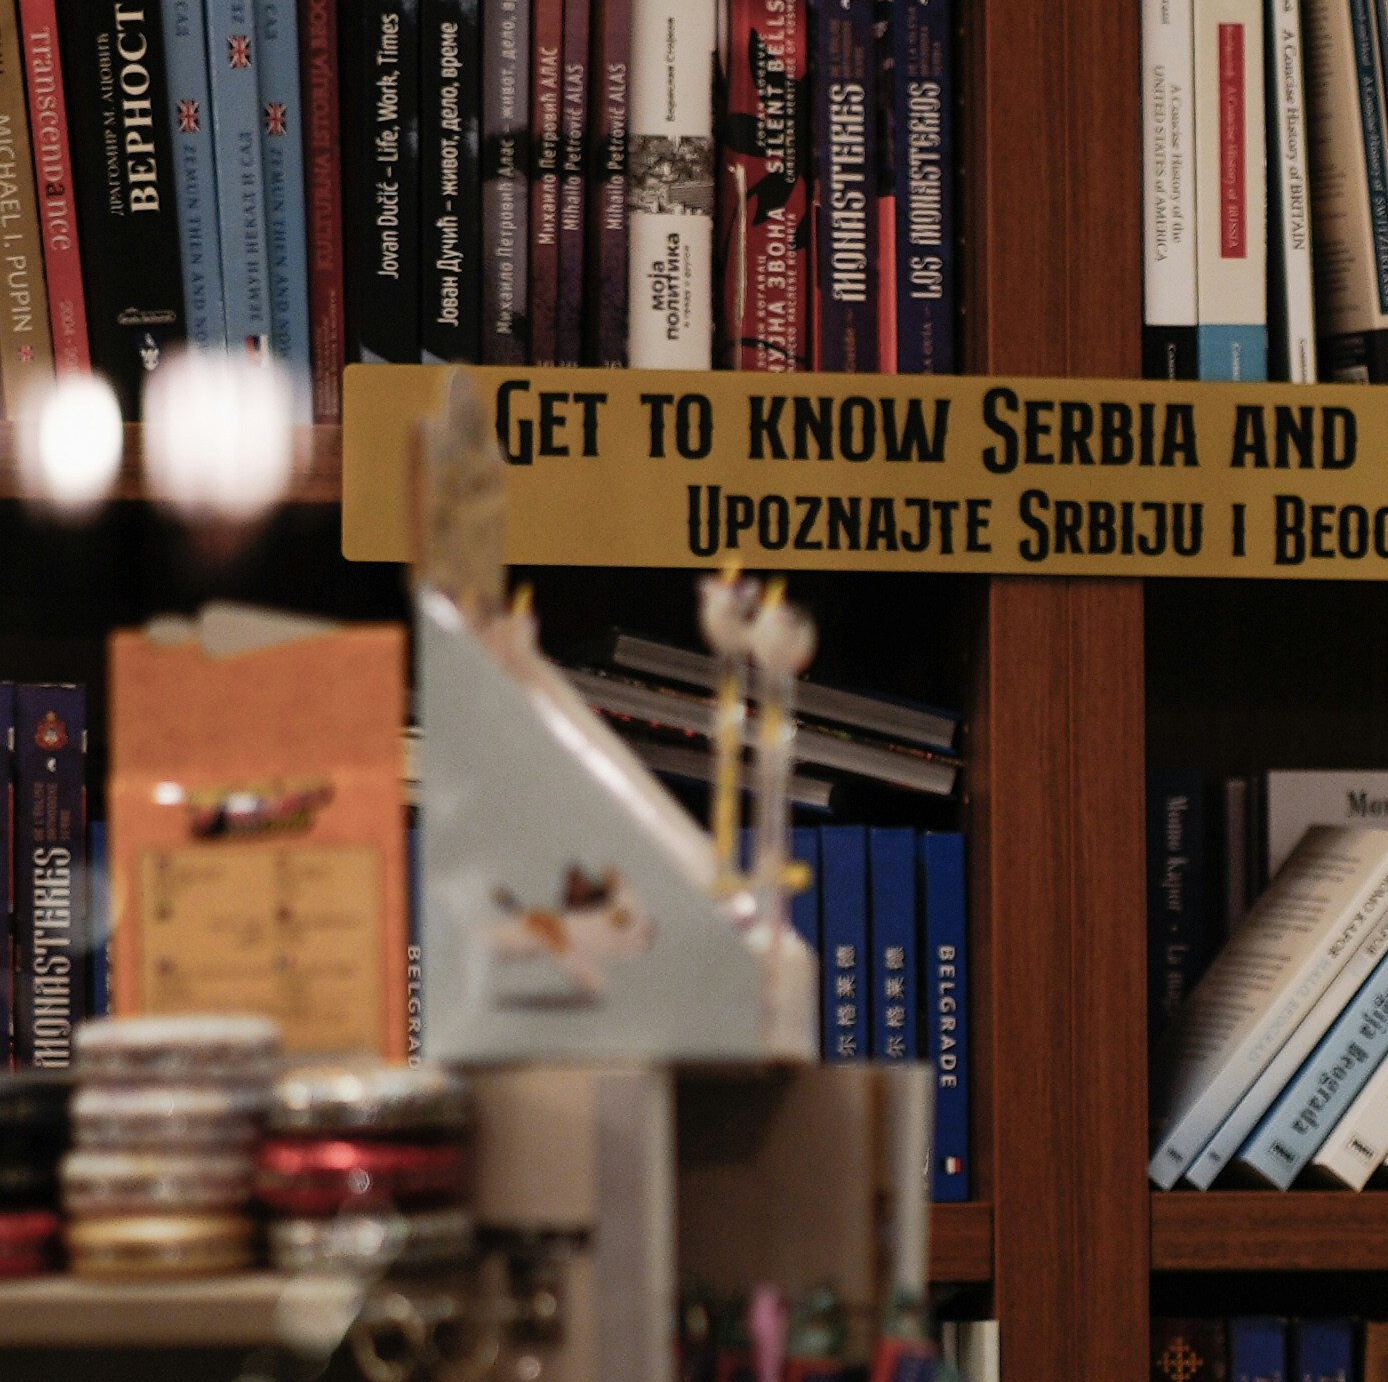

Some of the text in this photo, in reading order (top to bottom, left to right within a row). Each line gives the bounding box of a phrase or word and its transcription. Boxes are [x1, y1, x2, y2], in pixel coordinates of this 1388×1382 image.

[115, 3, 162, 213] ВЕРНОСТ
[540, 47, 558, 90] АЛАС
[376, 13, 402, 280] Jovan Dučić Life, Work, Times
[436, 22, 465, 327] Јован Дучић живот, дело, време
[564, 63, 583, 232] Mihailo ALAS
[605, 62, 626, 231] Mihailo ALAS
[765, 84, 785, 174] SILENT
[1153, 65, 1168, 262] UNITED STATES AMERICA
[1170, 97, 1182, 150] Concise
[1283, 45, 1305, 251] Concise History BRITAIN
[1169, 153, 1183, 202] History
[8, 256, 34, 332] PUPIN
[647, 261, 670, 312] моја
[664, 232, 681, 341] политика
[767, 207, 786, 289] ЗВОНА
[908, 256, 943, 299] LOS
[980, 385, 1202, 476] SERBIA
[686, 484, 993, 558] UPOZNAJTE
[1017, 487, 1205, 564] SRBIJU
[1230, 502, 1247, 558] I
[936, 944, 957, 1089] BELGRADE
[1286, 1038, 1370, 1140] Beograda
